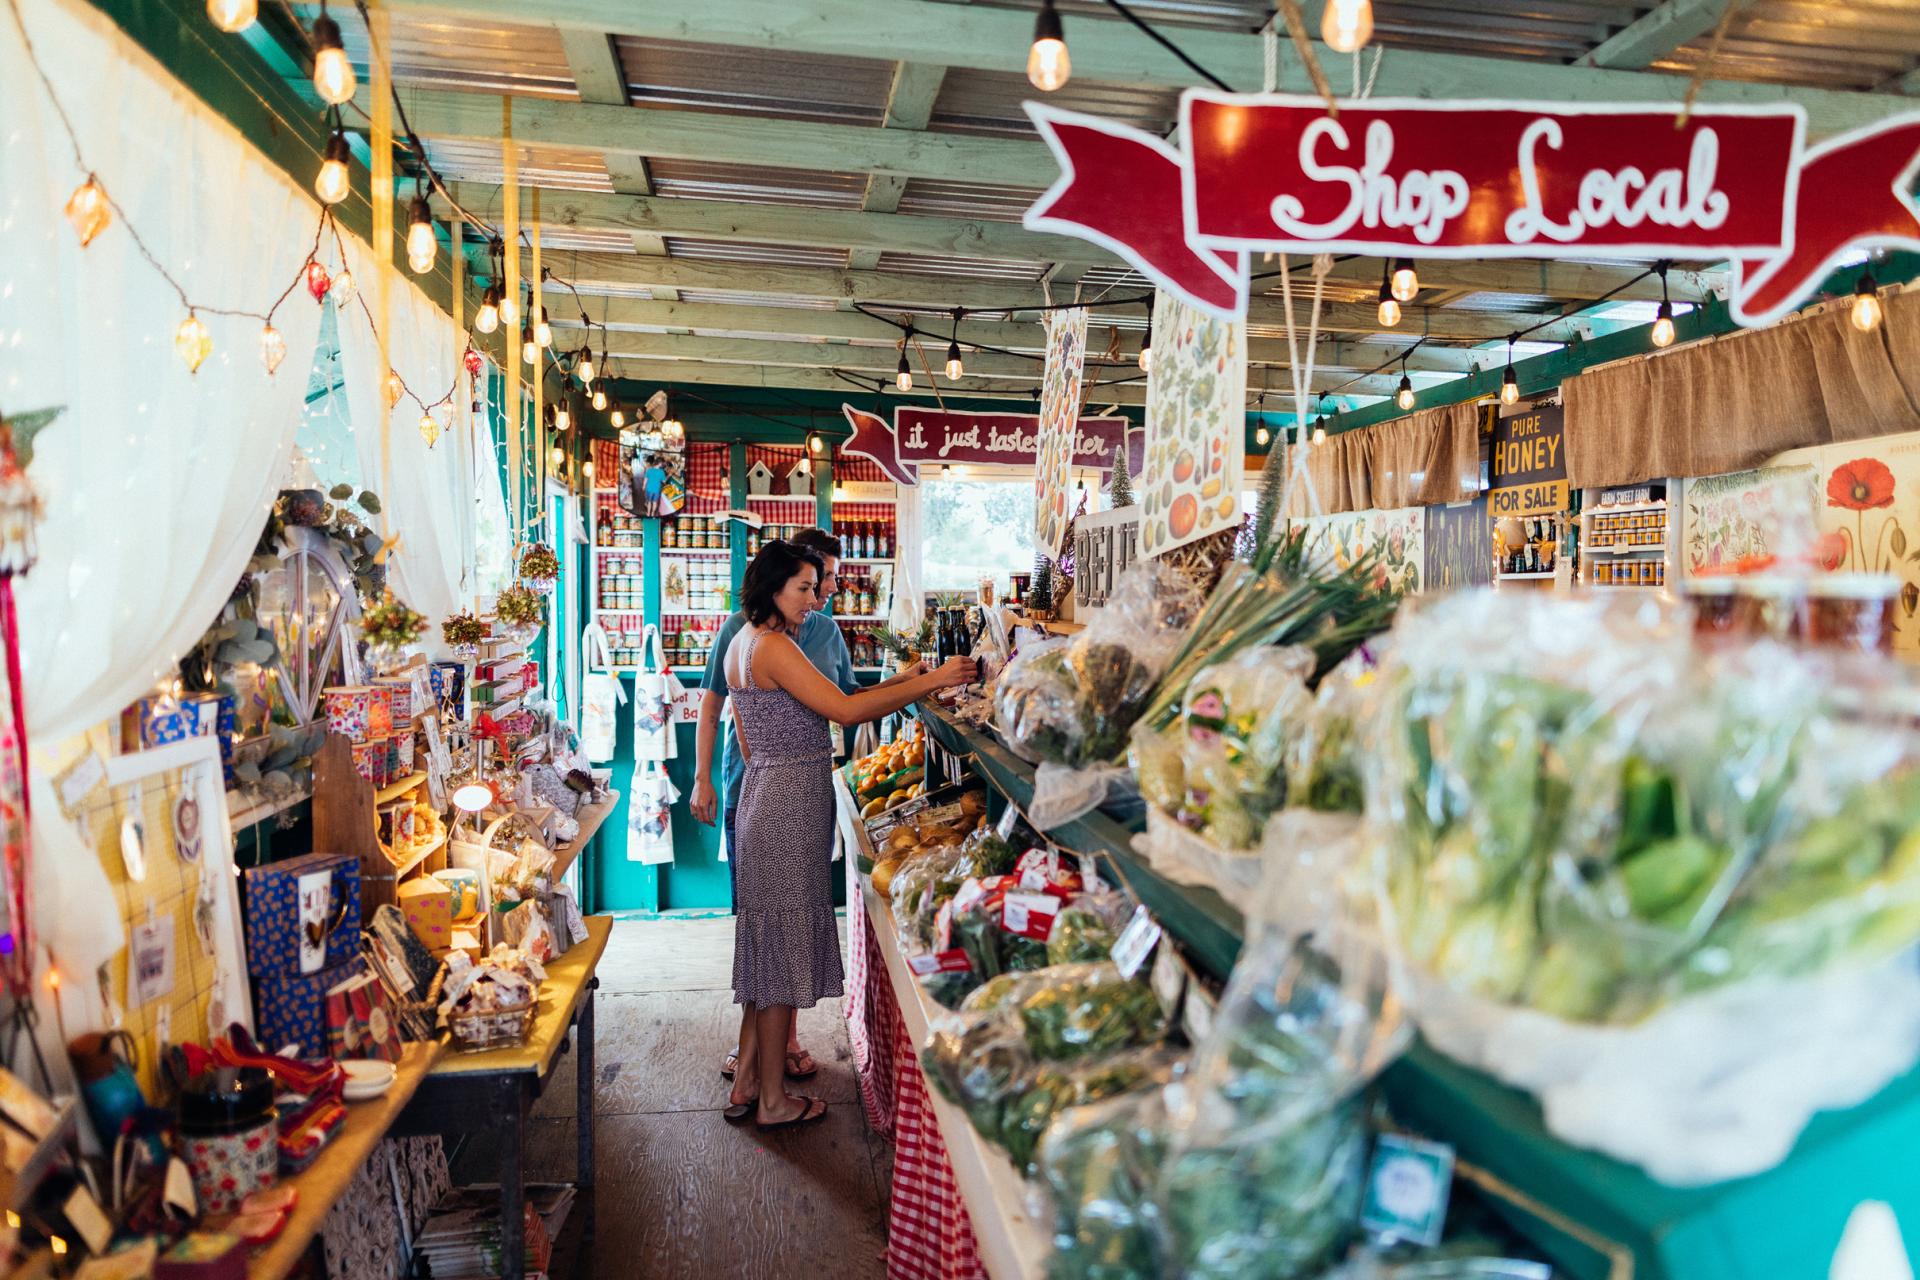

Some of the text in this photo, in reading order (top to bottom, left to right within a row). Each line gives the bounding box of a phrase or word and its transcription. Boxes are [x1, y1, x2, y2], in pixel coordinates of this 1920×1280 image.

[1270, 116, 1730, 244] Shop Local
[904, 421, 929, 449] it
[938, 424, 982, 458] just
[1511, 415, 1541, 438] PURE
[1494, 433, 1561, 477] HONEY
[1494, 485, 1558, 513] FOR SALE
[1616, 489, 1634, 504] SWEET
